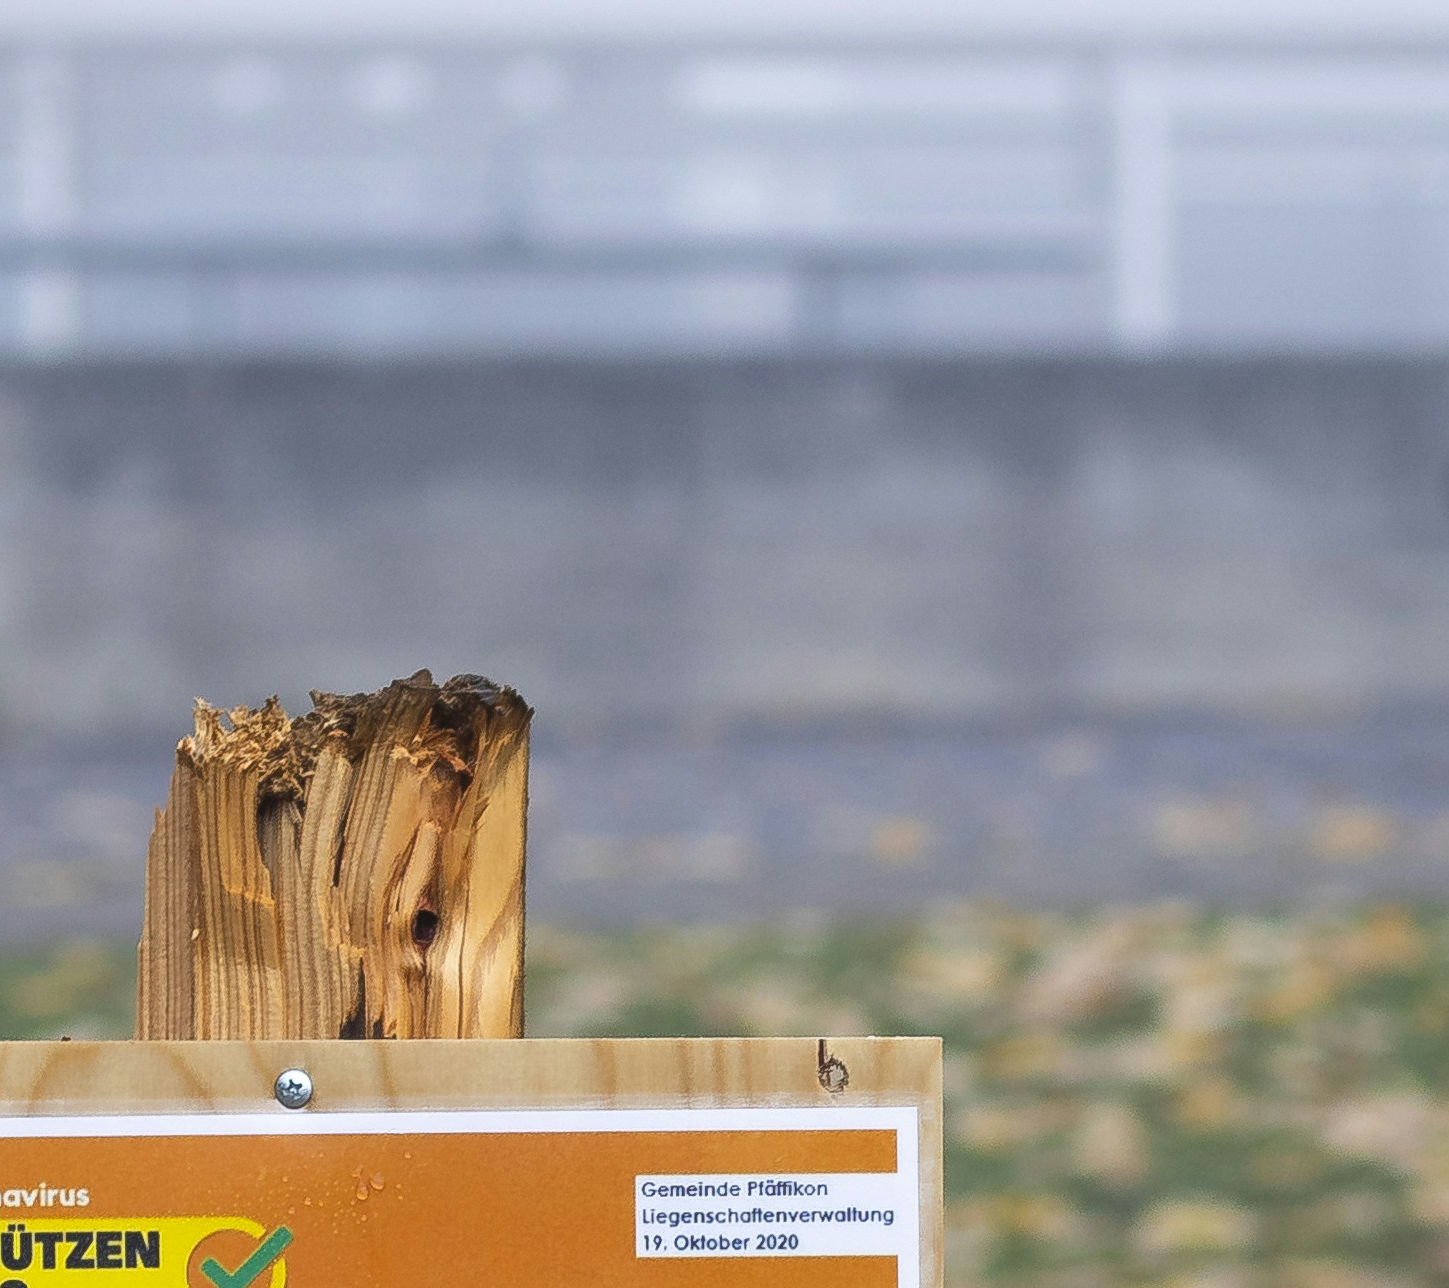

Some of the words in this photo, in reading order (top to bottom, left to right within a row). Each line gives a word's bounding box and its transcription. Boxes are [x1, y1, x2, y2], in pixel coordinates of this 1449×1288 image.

[641, 1181, 741, 1197] Gemeinde
[747, 1180, 828, 1196] Pfäffikon
[642, 1207, 894, 1227] Liegenschaftenverwaltung
[642, 1235, 667, 1251] 19.
[674, 1235, 751, 1251] Oktober
[756, 1234, 799, 1250] 2020
